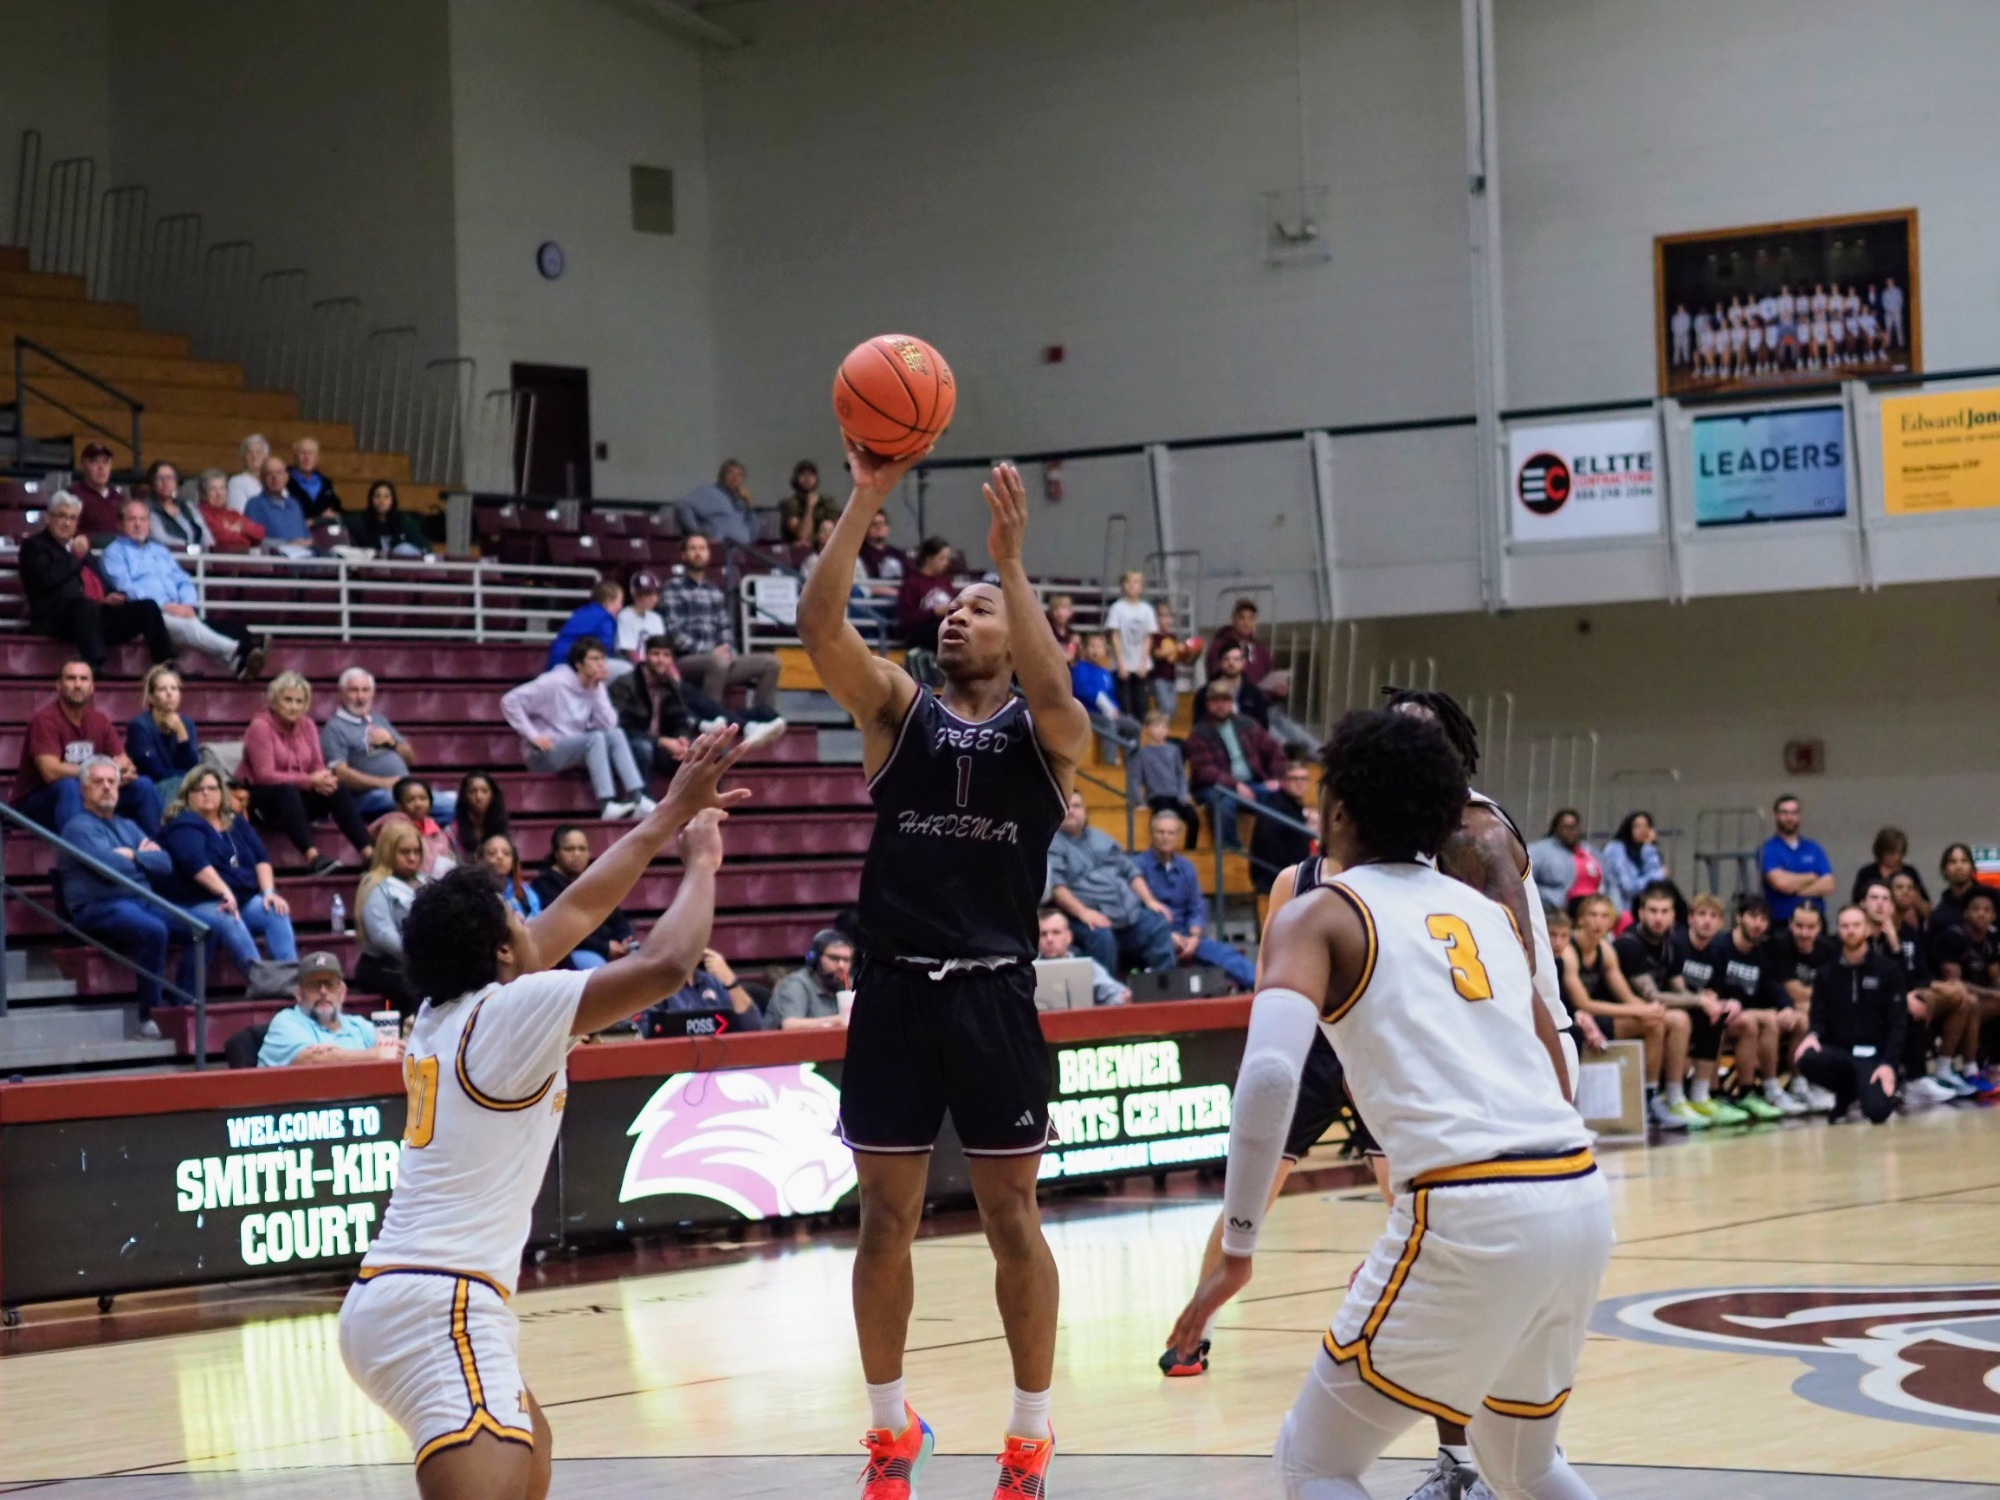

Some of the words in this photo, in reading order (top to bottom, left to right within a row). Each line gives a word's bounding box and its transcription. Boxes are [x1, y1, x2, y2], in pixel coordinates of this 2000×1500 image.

[1901, 408, 1963, 432] Edward
[1966, 407, 2000, 429] Jon
[1573, 452, 1653, 476] ELITE
[1700, 441, 1842, 477] LEADERS
[934, 727, 1009, 753] FREED
[956, 755, 972, 808] 1
[898, 810, 1018, 844] HARDEMAN
[1425, 913, 1494, 1003] 3
[686, 1017, 715, 1034] POSS.
[1058, 1040, 1181, 1094] BREWER
[226, 1109, 346, 1148] WELCOME
[348, 1106, 381, 1137] TO
[1123, 1084, 1231, 1138] CENTER
[176, 1140, 407, 1212] SMITH-KIR
[240, 1202, 376, 1265] COURT
